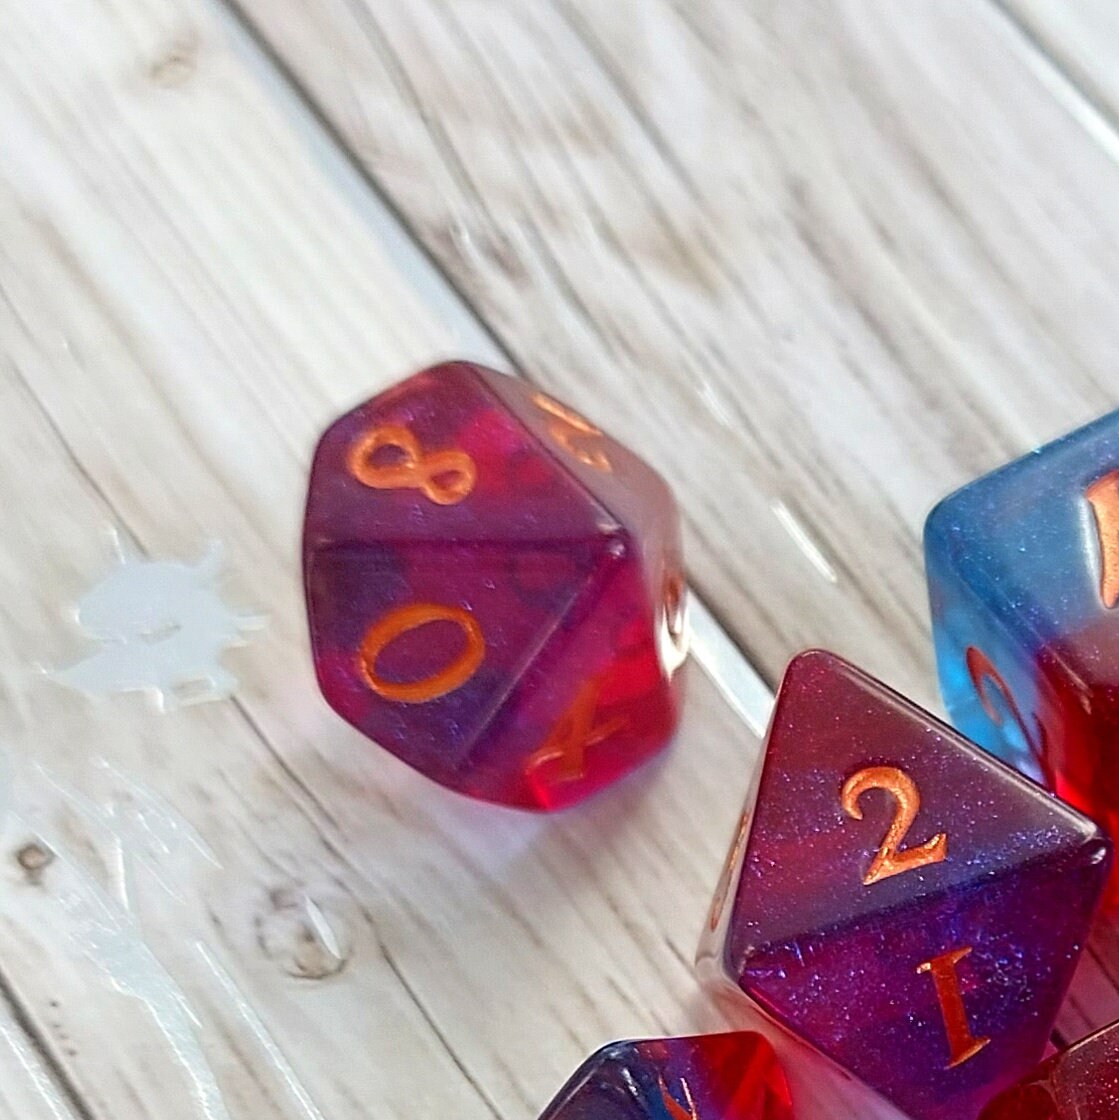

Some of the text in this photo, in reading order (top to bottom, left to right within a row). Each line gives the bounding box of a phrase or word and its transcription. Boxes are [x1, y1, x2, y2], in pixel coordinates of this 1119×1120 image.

[348, 424, 476, 505] 8
[840, 766, 947, 885] 2
[916, 947, 991, 1070] 1
